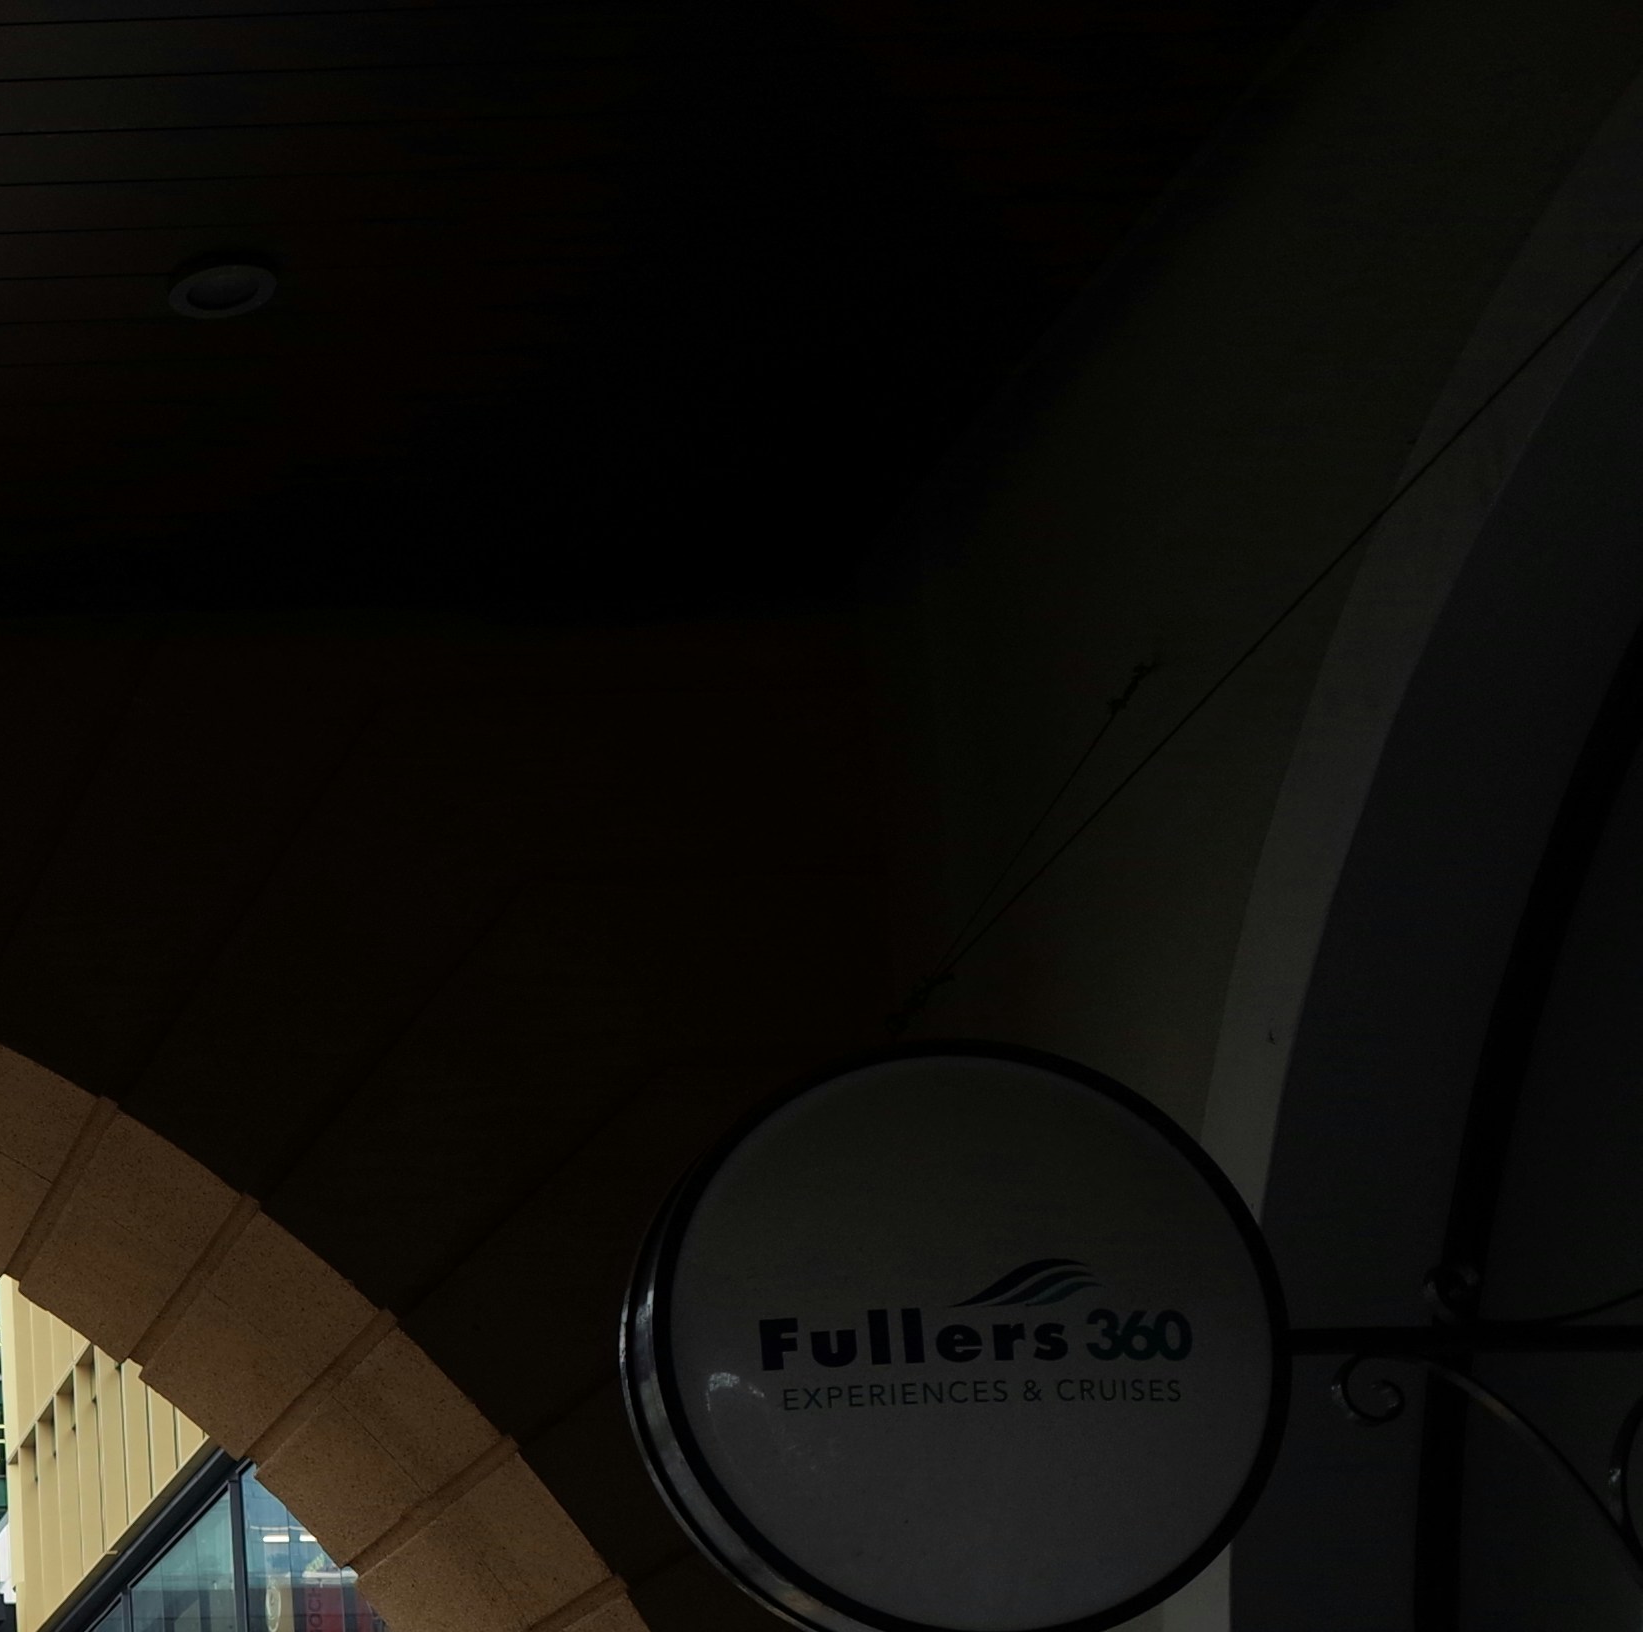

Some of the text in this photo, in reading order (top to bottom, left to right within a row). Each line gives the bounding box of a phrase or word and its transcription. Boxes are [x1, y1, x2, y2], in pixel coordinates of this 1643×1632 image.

[758, 1307, 1193, 1371] Fullers 360
[782, 1379, 1182, 1411] EXPERIENCES & CRUISES
